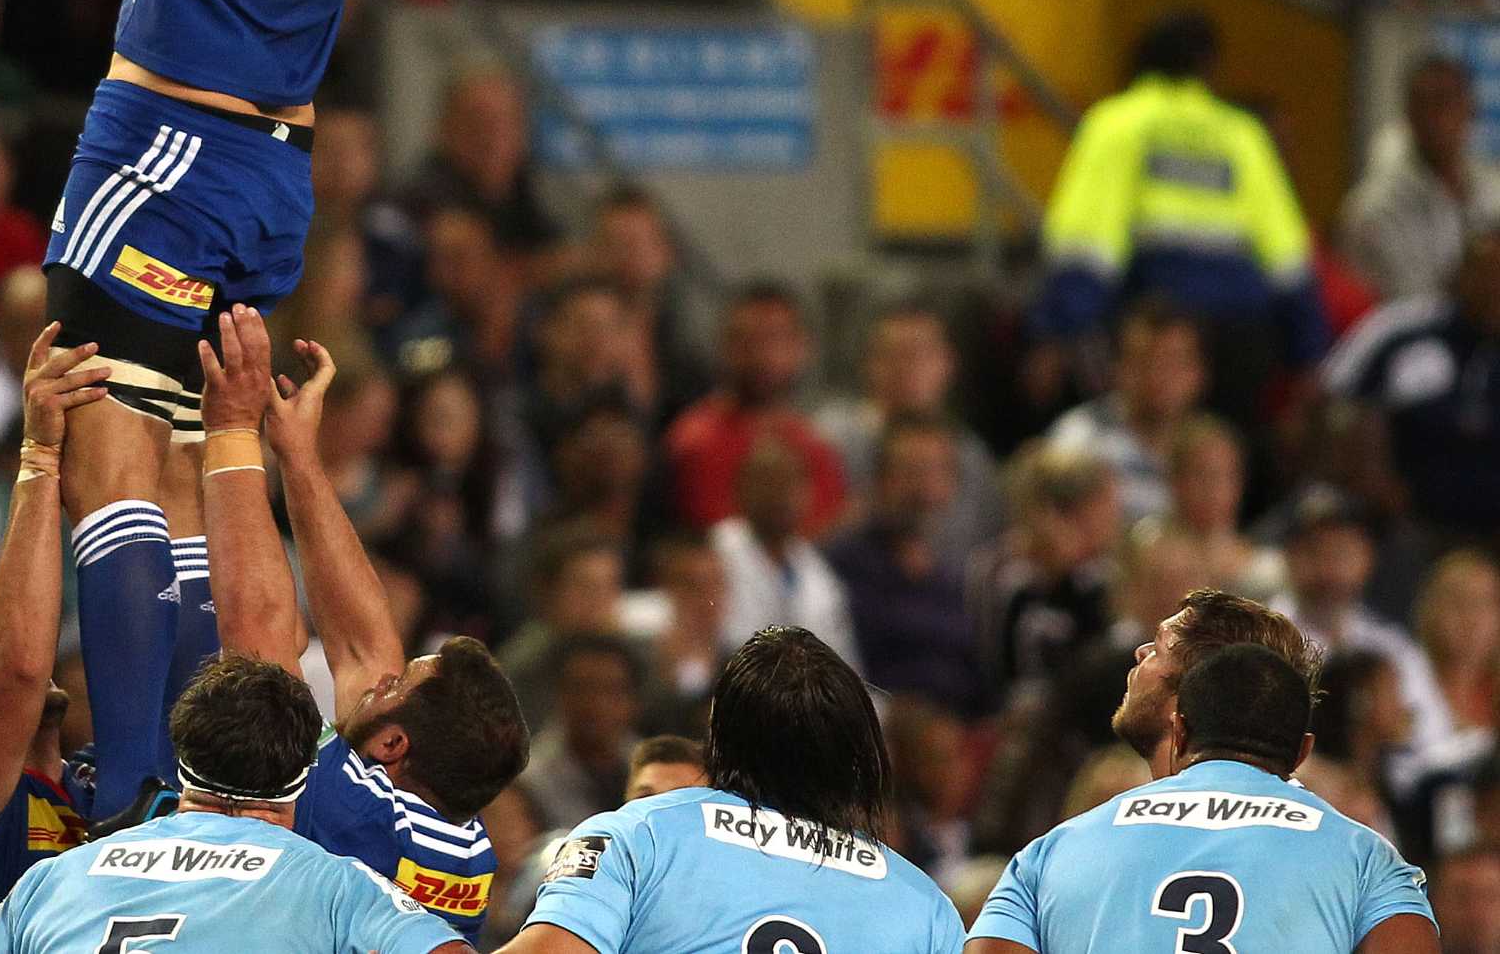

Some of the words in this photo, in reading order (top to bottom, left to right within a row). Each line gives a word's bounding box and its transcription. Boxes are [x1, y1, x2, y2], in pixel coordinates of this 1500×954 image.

[136, 262, 212, 304] DHL
[1124, 798, 1200, 822] Ray
[1206, 797, 1308, 823] White
[713, 808, 779, 847] Ray
[785, 822, 877, 867] White
[99, 847, 166, 874] Ray
[171, 845, 266, 873] White
[408, 872, 483, 910] DHL
[1150, 869, 1245, 954] 3
